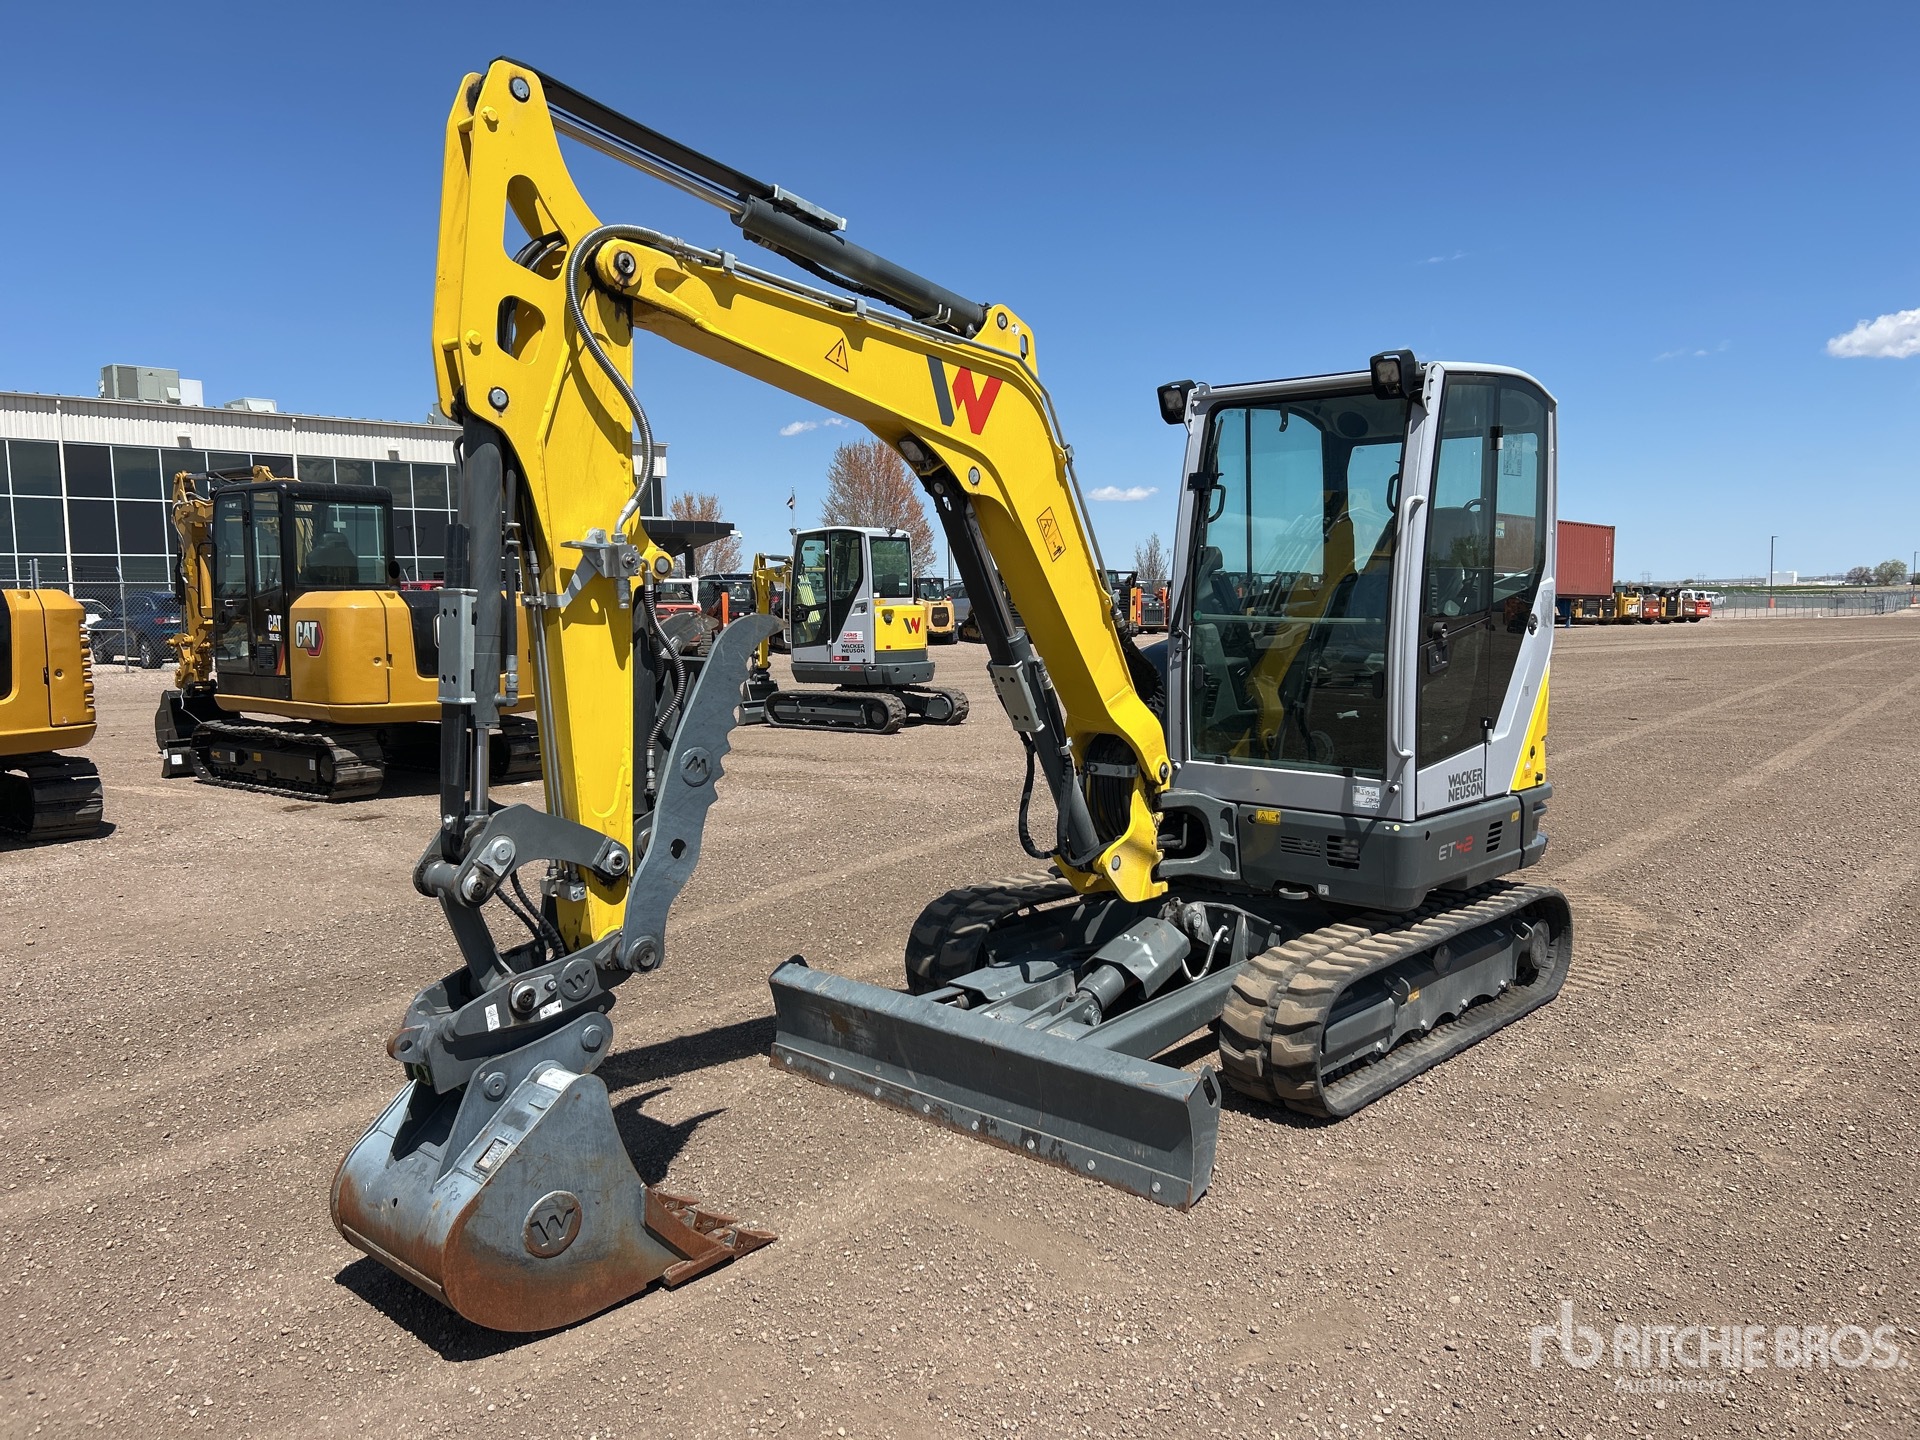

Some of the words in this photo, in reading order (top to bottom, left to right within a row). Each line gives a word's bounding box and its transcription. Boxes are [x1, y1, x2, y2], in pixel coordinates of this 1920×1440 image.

[1627, 604, 1639, 614] CAT
[268, 614, 282, 631] CAT
[296, 621, 317, 648] CAT
[1448, 768, 1483, 788] WACKER
[1448, 781, 1483, 802] NEUSON
[1438, 834, 1474, 861] ET42
